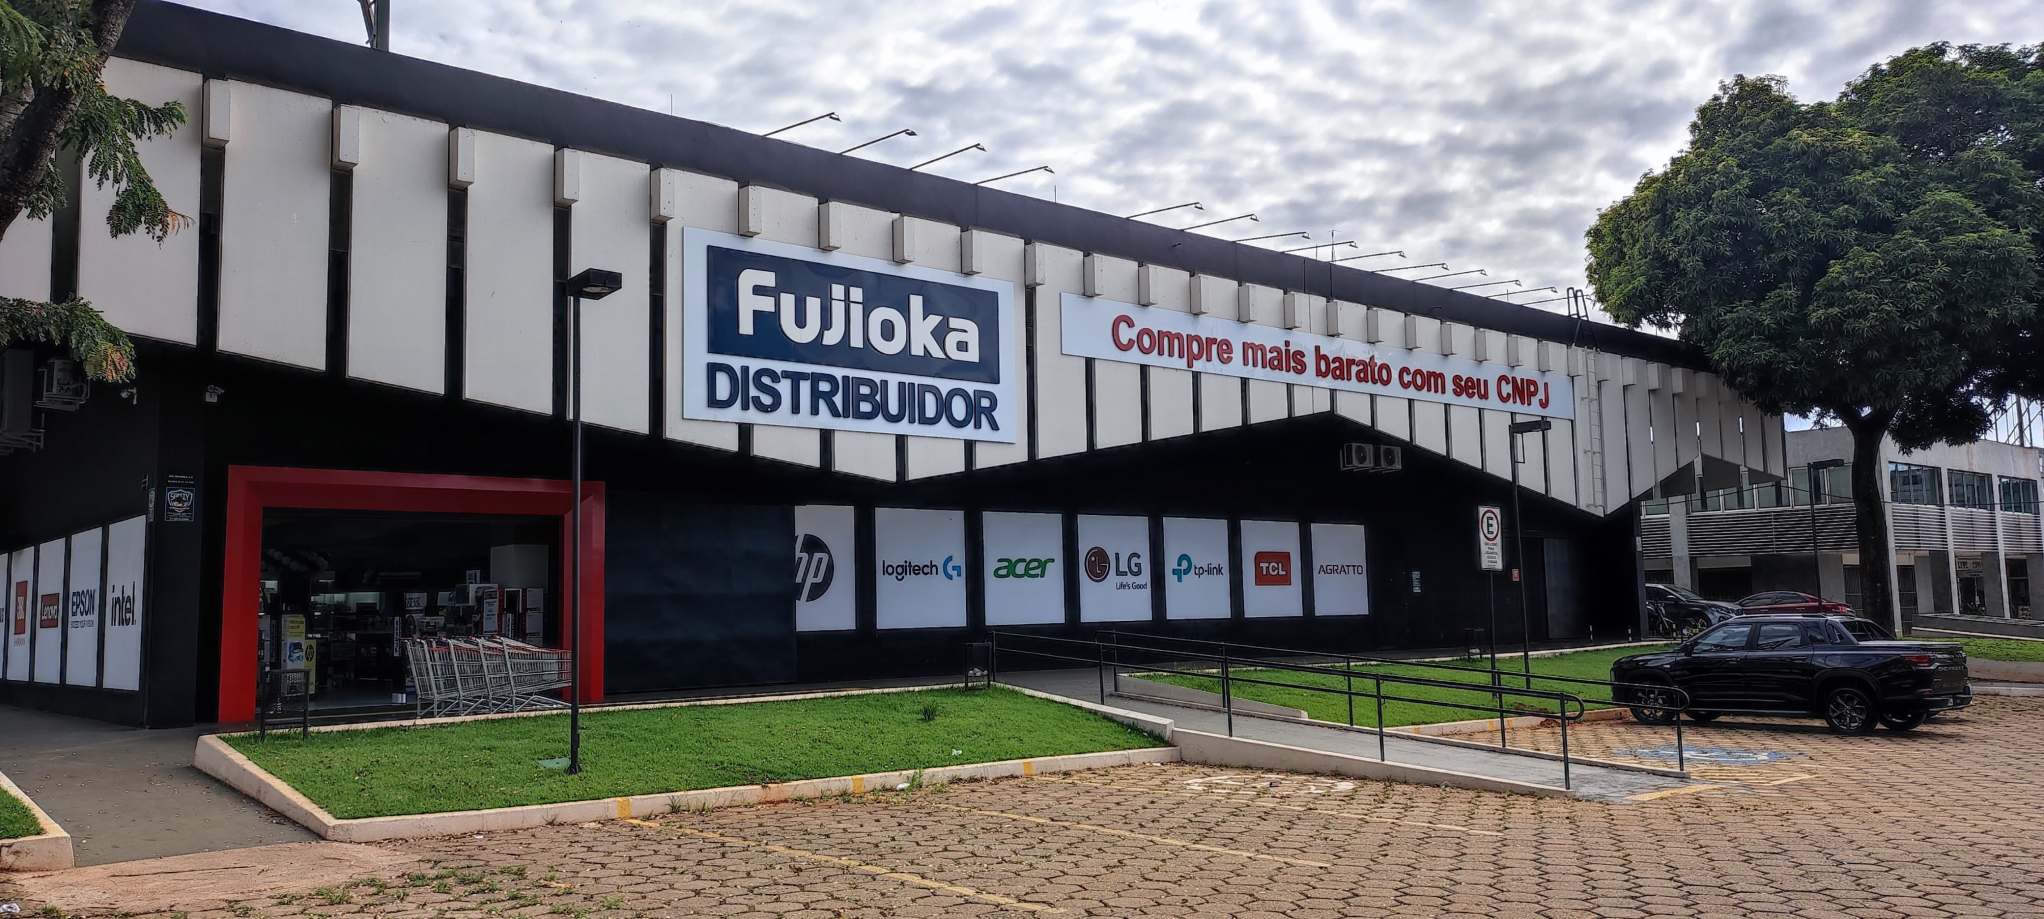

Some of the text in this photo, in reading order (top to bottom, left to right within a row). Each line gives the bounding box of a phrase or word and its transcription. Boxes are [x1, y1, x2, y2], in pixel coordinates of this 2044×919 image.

[737, 268, 980, 363] Fujioka
[1111, 314, 1550, 409] Compre mais barato com seu CNPJ
[706, 361, 1000, 431] DISTRIBUIDOR
[1486, 516, 1494, 534] E
[882, 559, 938, 582] logitech
[993, 557, 1055, 579] acer
[1115, 552, 1142, 576] LG
[1193, 563, 1224, 578] tp-link
[1259, 562, 1286, 575] TCL
[1317, 564, 1364, 575] AGRATTO
[1115, 581, 1147, 590] Life's Good
[71, 589, 95, 617] EPSON
[111, 581, 136, 627] intel
